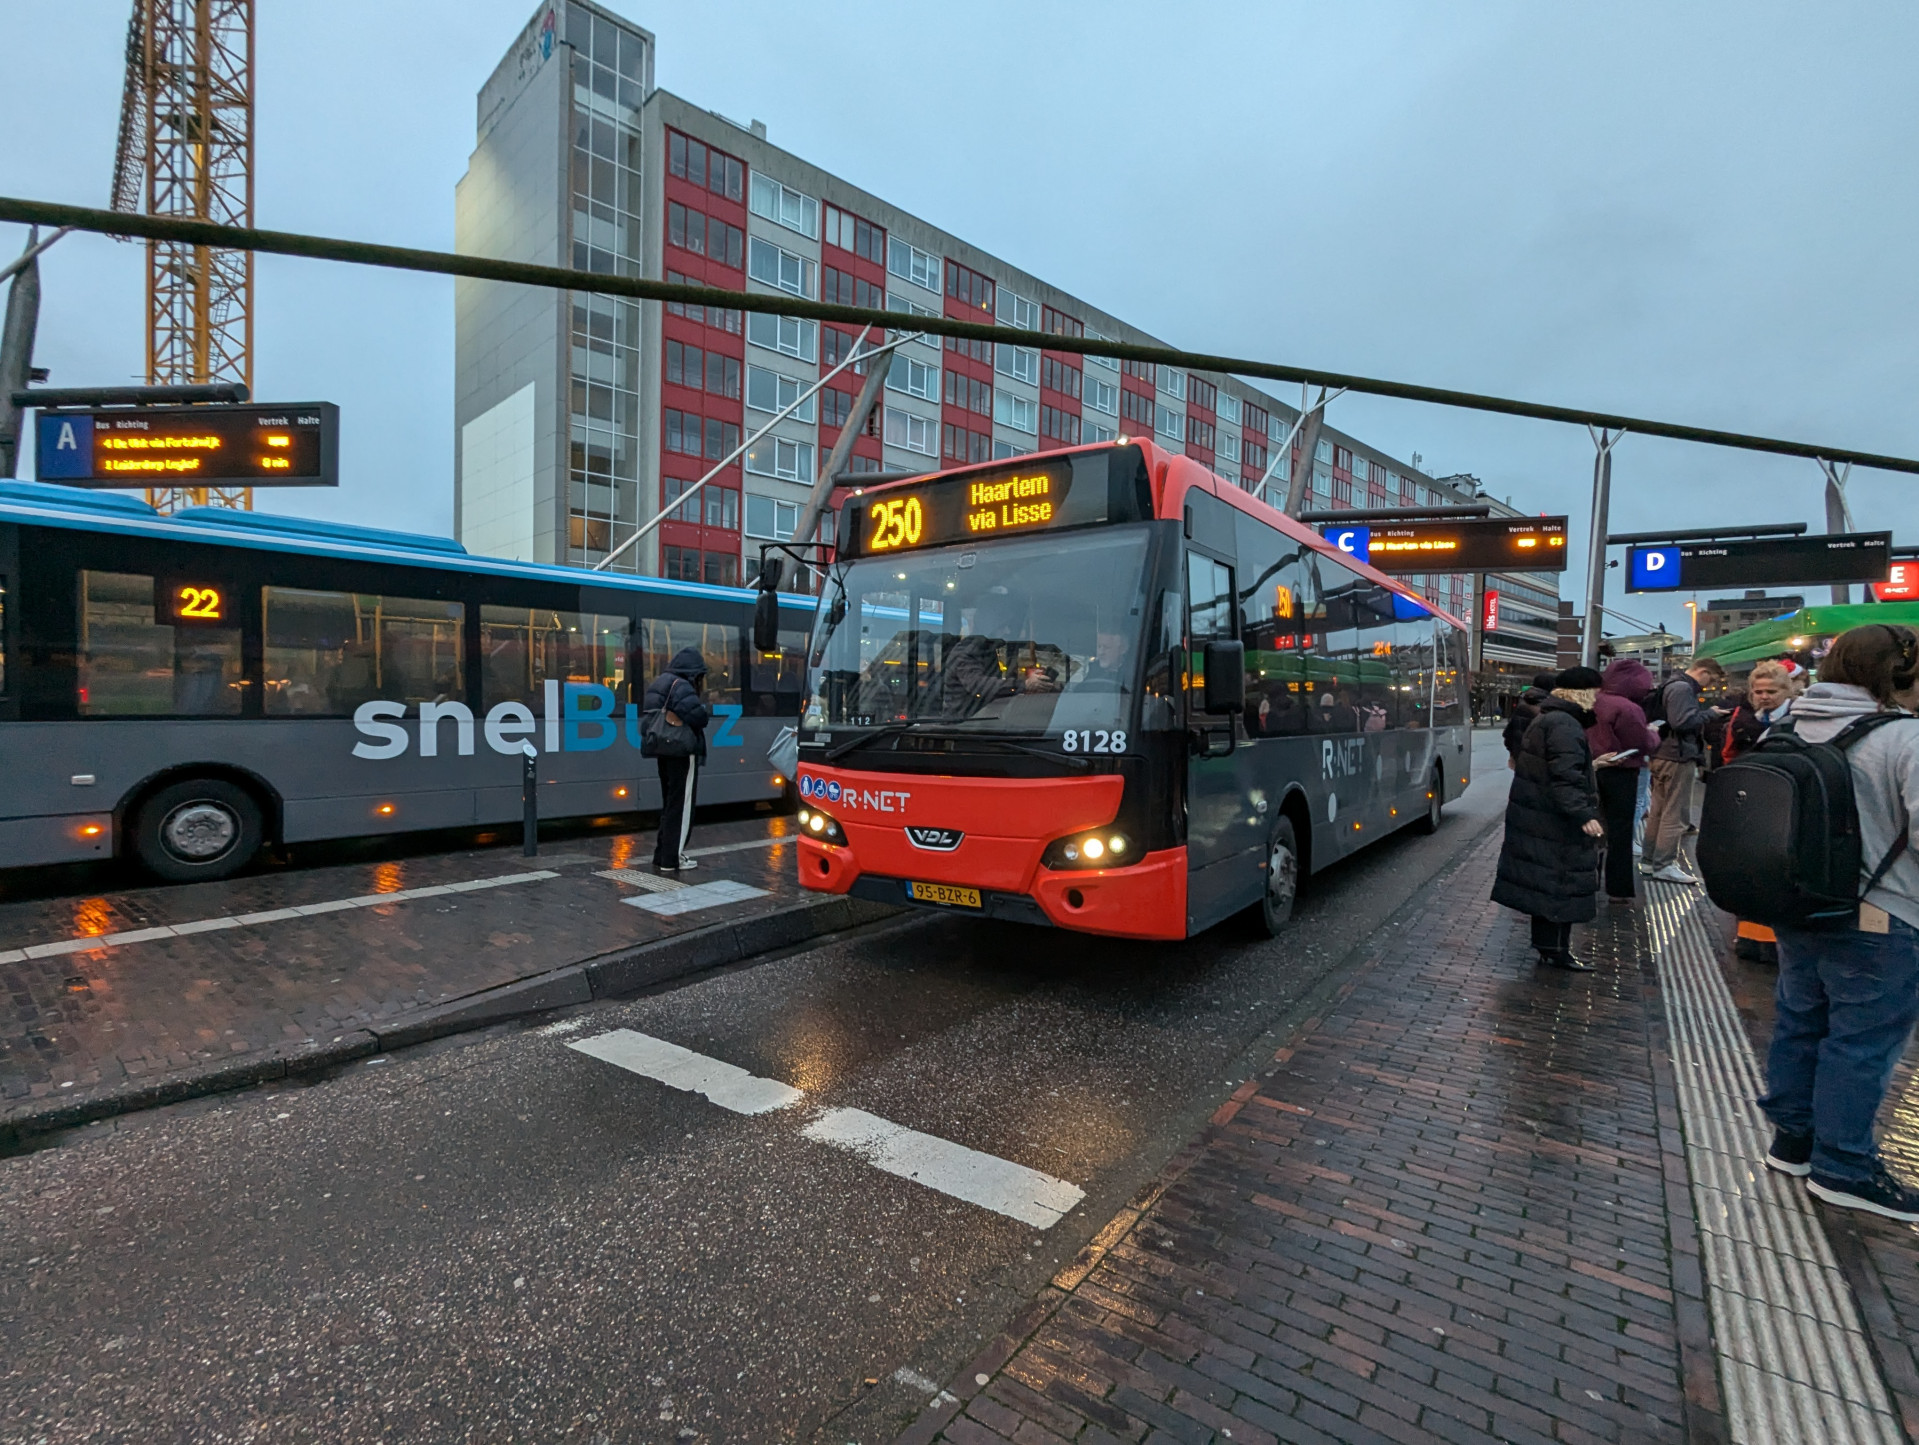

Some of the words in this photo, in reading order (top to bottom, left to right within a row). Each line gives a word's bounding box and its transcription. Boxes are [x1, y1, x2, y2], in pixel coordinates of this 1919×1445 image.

[95, 422, 110, 430] Bus
[116, 420, 149, 430] Richting
[258, 416, 289, 426] Vertrek
[297, 415, 320, 425] Halte
[57, 421, 77, 450] A
[971, 475, 1049, 505] Haarlem
[871, 497, 922, 549] 250
[969, 508, 997, 531] via
[1002, 502, 1052, 526] Lisse
[1508, 525, 1534, 533] Vertrek
[1542, 524, 1562, 532] Halte
[1338, 532, 1355, 552] C
[1646, 552, 1665, 571] D
[1890, 566, 1905, 584] E
[180, 587, 219, 618] 22
[1486, 614, 1496, 629] ibis
[351, 679, 744, 760] snelBz
[1062, 729, 1127, 753] 8128
[913, 829, 953, 844] VDL
[916, 884, 977, 905] 95-BZR-6
